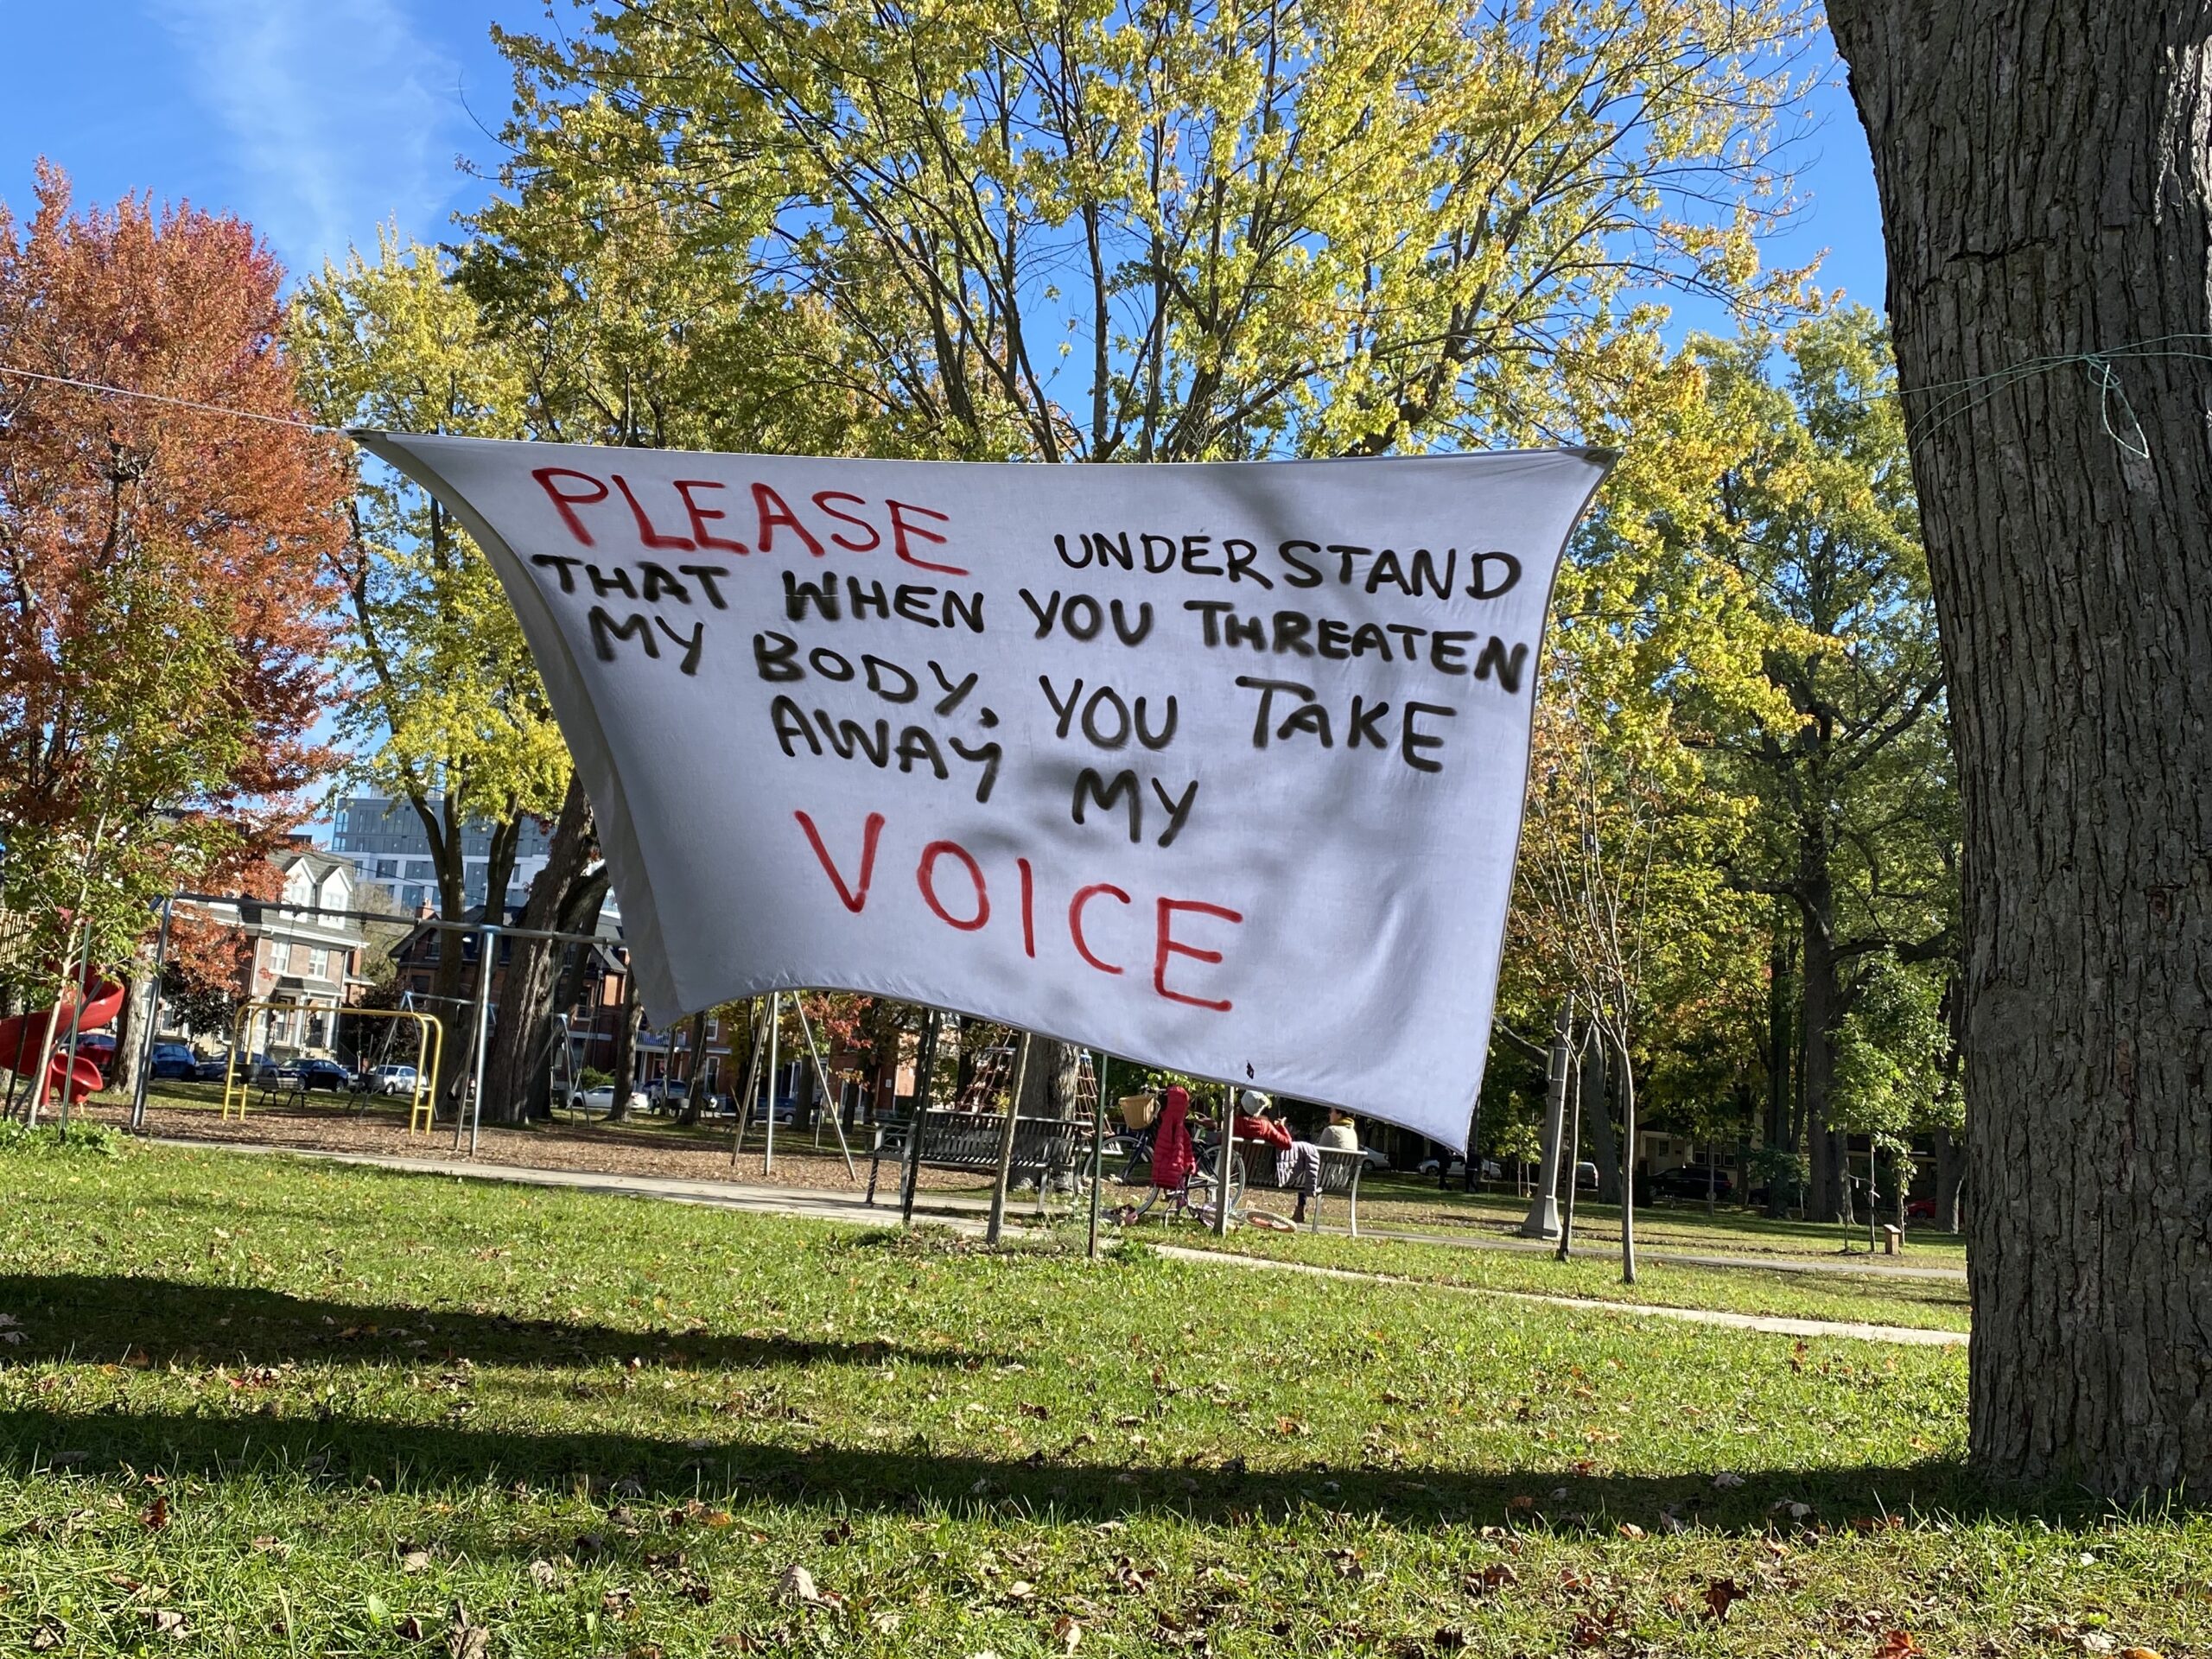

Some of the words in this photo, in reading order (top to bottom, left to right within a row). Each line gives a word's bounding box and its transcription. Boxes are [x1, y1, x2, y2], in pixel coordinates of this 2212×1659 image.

[531, 467, 970, 576] PLEASE
[1054, 531, 1522, 600] UNDERSTAND
[531, 554, 730, 609] THAT
[782, 569, 985, 633] WHEN
[1018, 588, 1153, 646] YOU
[1184, 600, 1529, 693] THREATEN
[588, 606, 704, 677] MY
[1039, 675, 1177, 750] YOU
[1235, 676, 1457, 772] TAKE
[771, 695, 1001, 804] AWAY
[1071, 768, 1198, 848] MY
[794, 810, 1243, 1013] VOICE
